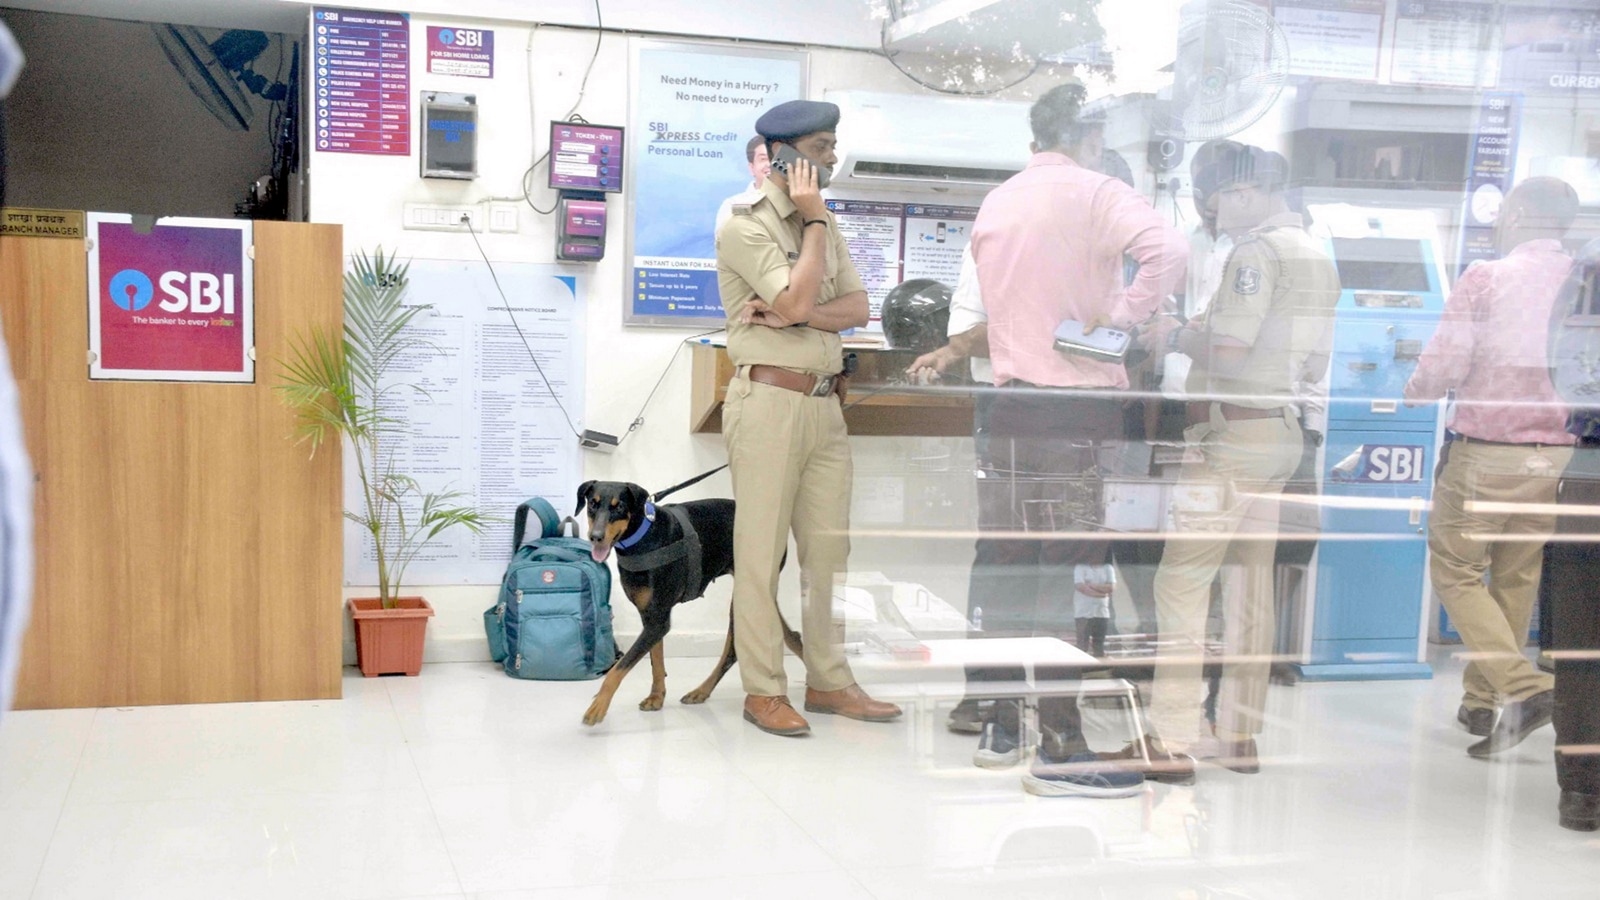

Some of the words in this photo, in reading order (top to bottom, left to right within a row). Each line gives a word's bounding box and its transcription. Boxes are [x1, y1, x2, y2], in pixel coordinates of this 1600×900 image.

[324, 12, 339, 21] SBI
[455, 29, 482, 47] SBI
[660, 75, 687, 85] Need
[689, 77, 722, 90] Money
[724, 79, 734, 89] in
[735, 81, 741, 89] a
[742, 81, 771, 93] Hurry
[675, 91, 690, 101] No
[691, 93, 717, 103] need
[718, 95, 729, 103] to
[731, 97, 764, 108] worry!
[1489, 98, 1505, 110] SBI
[649, 121, 668, 132] SBI
[1480, 127, 1512, 135] CURRENT
[704, 132, 738, 142] Credit
[1478, 137, 1512, 145] ACCOUNT
[648, 145, 695, 157] Personal
[697, 148, 723, 159] Loan
[1477, 147, 1510, 156] VARIANTS
[834, 202, 845, 210] SBI
[913, 206, 924, 214] SBI
[35, 226, 79, 235] MANAGER
[158, 270, 235, 314] SBI
[132, 316, 148, 325] The
[149, 316, 176, 326] banker
[178, 317, 186, 326] to
[187, 318, 209, 328] every
[1368, 446, 1423, 481] SBI
